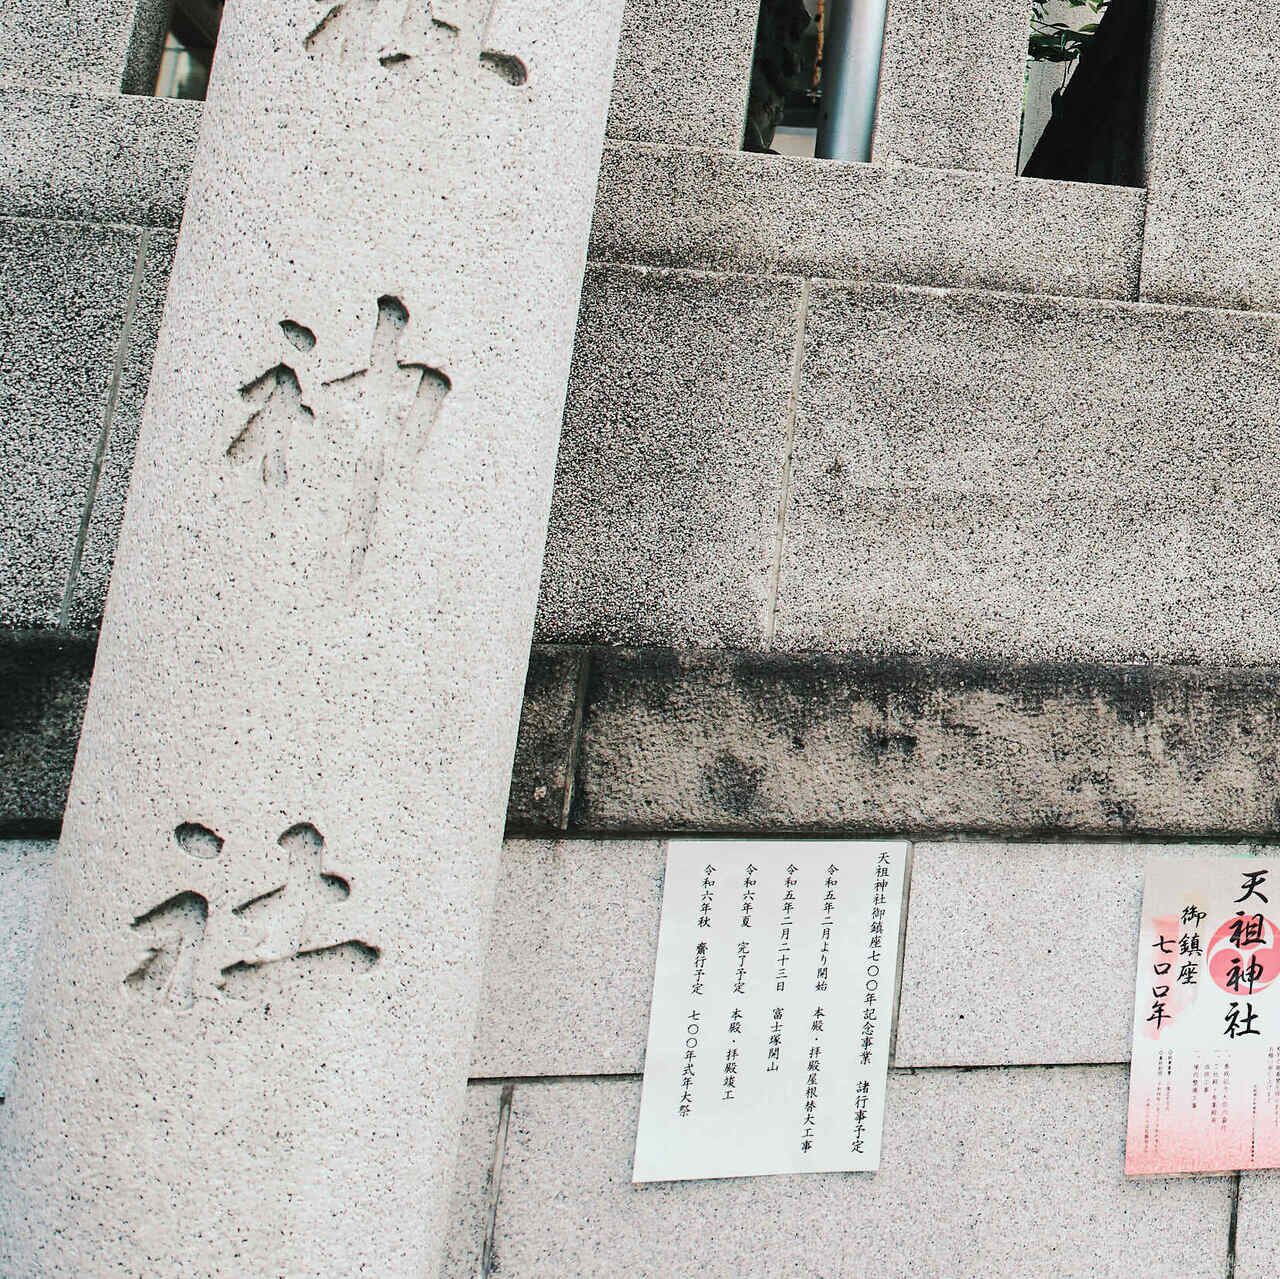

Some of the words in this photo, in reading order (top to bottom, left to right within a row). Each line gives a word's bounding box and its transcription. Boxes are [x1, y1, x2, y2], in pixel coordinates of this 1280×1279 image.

[697, 864, 717, 928] 令和六年秋
[740, 863, 759, 928] 令和六年夏
[775, 864, 799, 992] 令和五年二月二十三日
[815, 864, 839, 992] 令和五年二月より開始
[732, 941, 750, 995] 完了予定
[1176, 904, 1207, 985] 御鎮座
[1222, 869, 1270, 1040] 天祖神社
[766, 1007, 785, 1073] 富士塚開山
[850, 1080, 870, 1154] 諸行事予定
